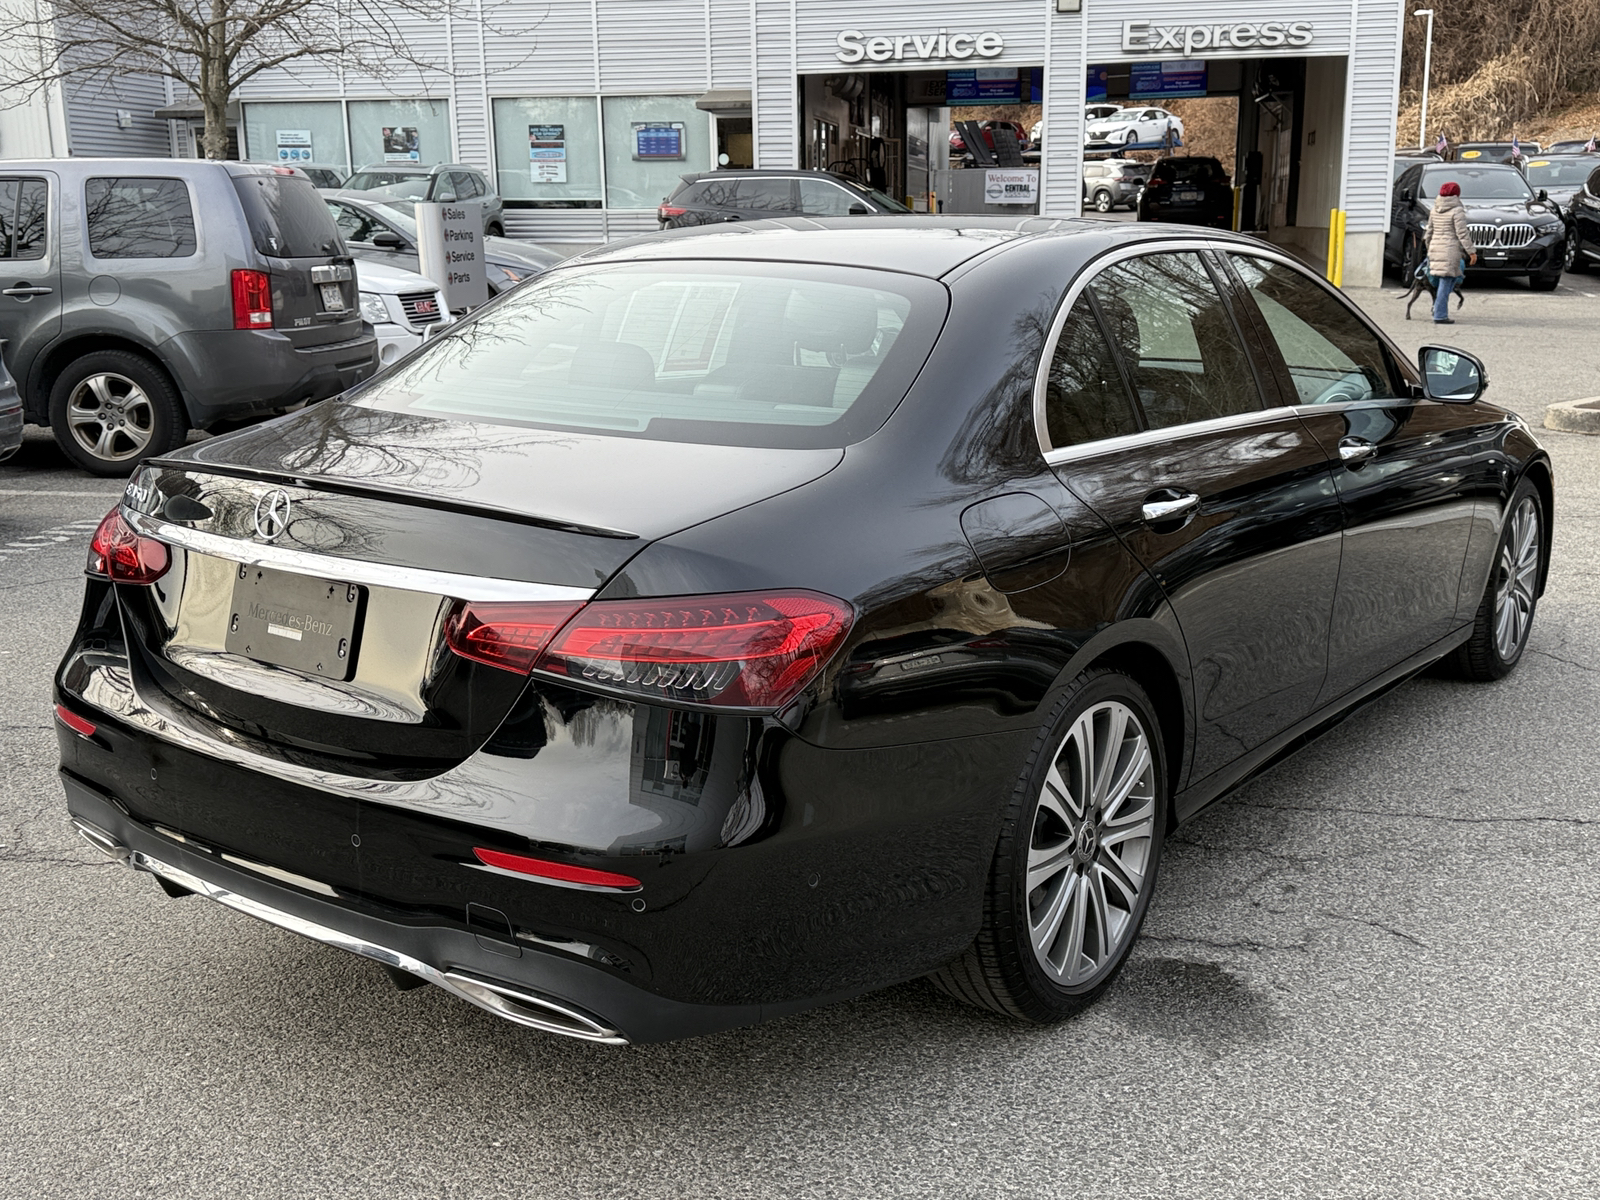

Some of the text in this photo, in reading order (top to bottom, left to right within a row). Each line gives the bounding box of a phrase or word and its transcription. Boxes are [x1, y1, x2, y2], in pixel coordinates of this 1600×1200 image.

[1121, 19, 1314, 57] Express
[835, 27, 1004, 63] Service
[987, 173, 1037, 183] Welcome To
[1004, 184, 1030, 192] CENTRAL
[447, 208, 466, 220] Sales
[449, 229, 474, 243] Parking
[451, 250, 475, 263] Service
[453, 272, 471, 284] Parts
[247, 601, 334, 637] Mercedes-Benz
